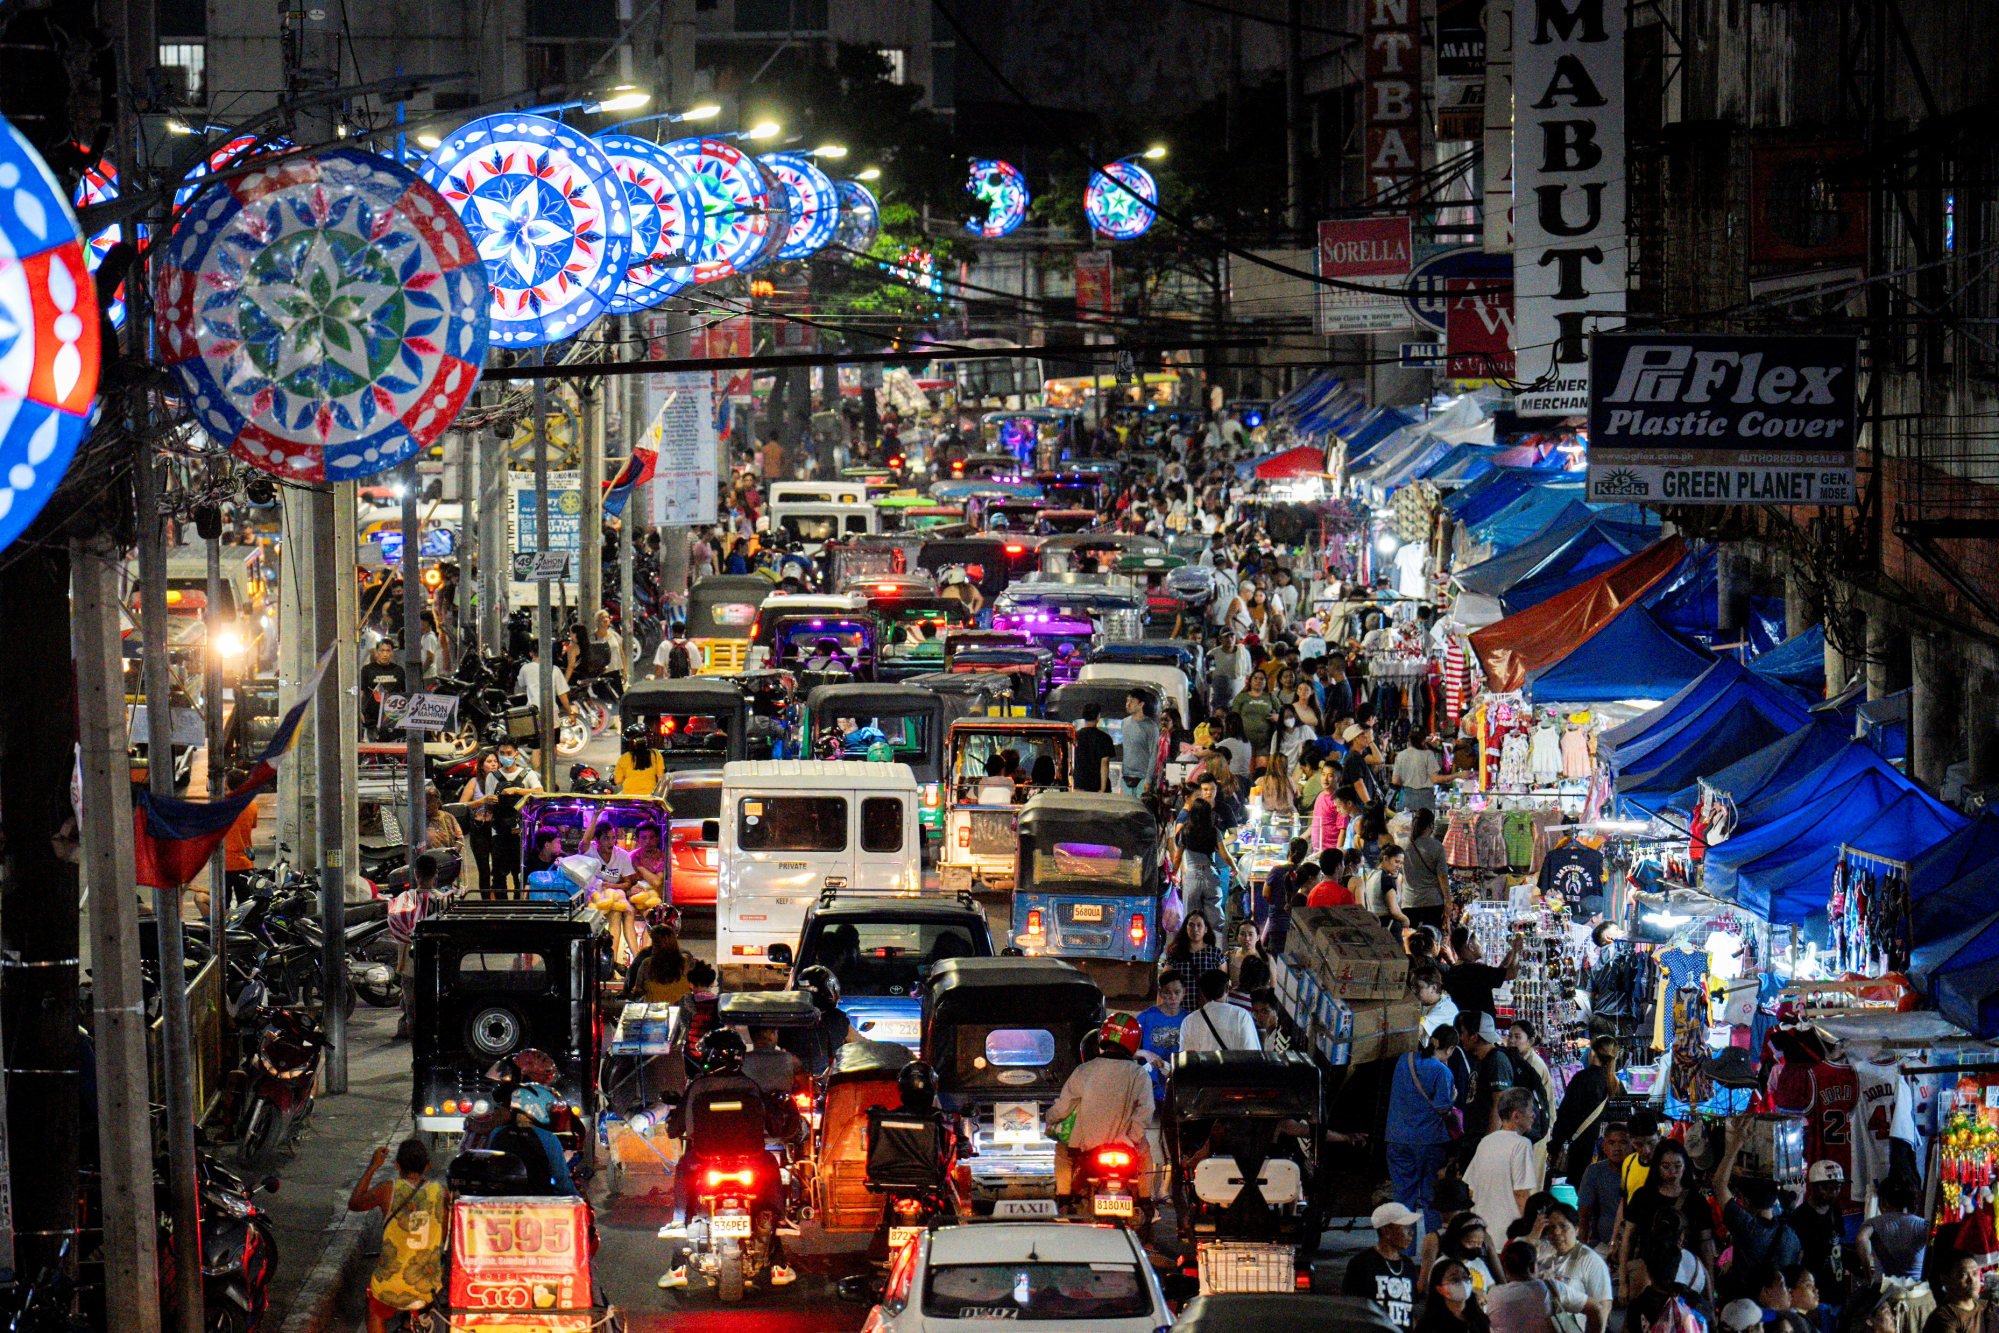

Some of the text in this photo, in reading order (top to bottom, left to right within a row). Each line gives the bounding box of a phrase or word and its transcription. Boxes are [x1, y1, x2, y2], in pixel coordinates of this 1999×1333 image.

[1323, 236, 1407, 263] SORELLA
[1604, 408, 1846, 438] Plastic Cover
[1737, 453, 1846, 464] AUTHORIZED DEALER
[1662, 470, 1816, 499] GREEN PLANET
[1820, 472, 1850, 485] GEN.
[1820, 487, 1850, 500] MDSE.
[778, 862, 807, 870] PRIVATE
[1823, 1108, 1851, 1144] 2
[1006, 1203, 1045, 1214] TAXI
